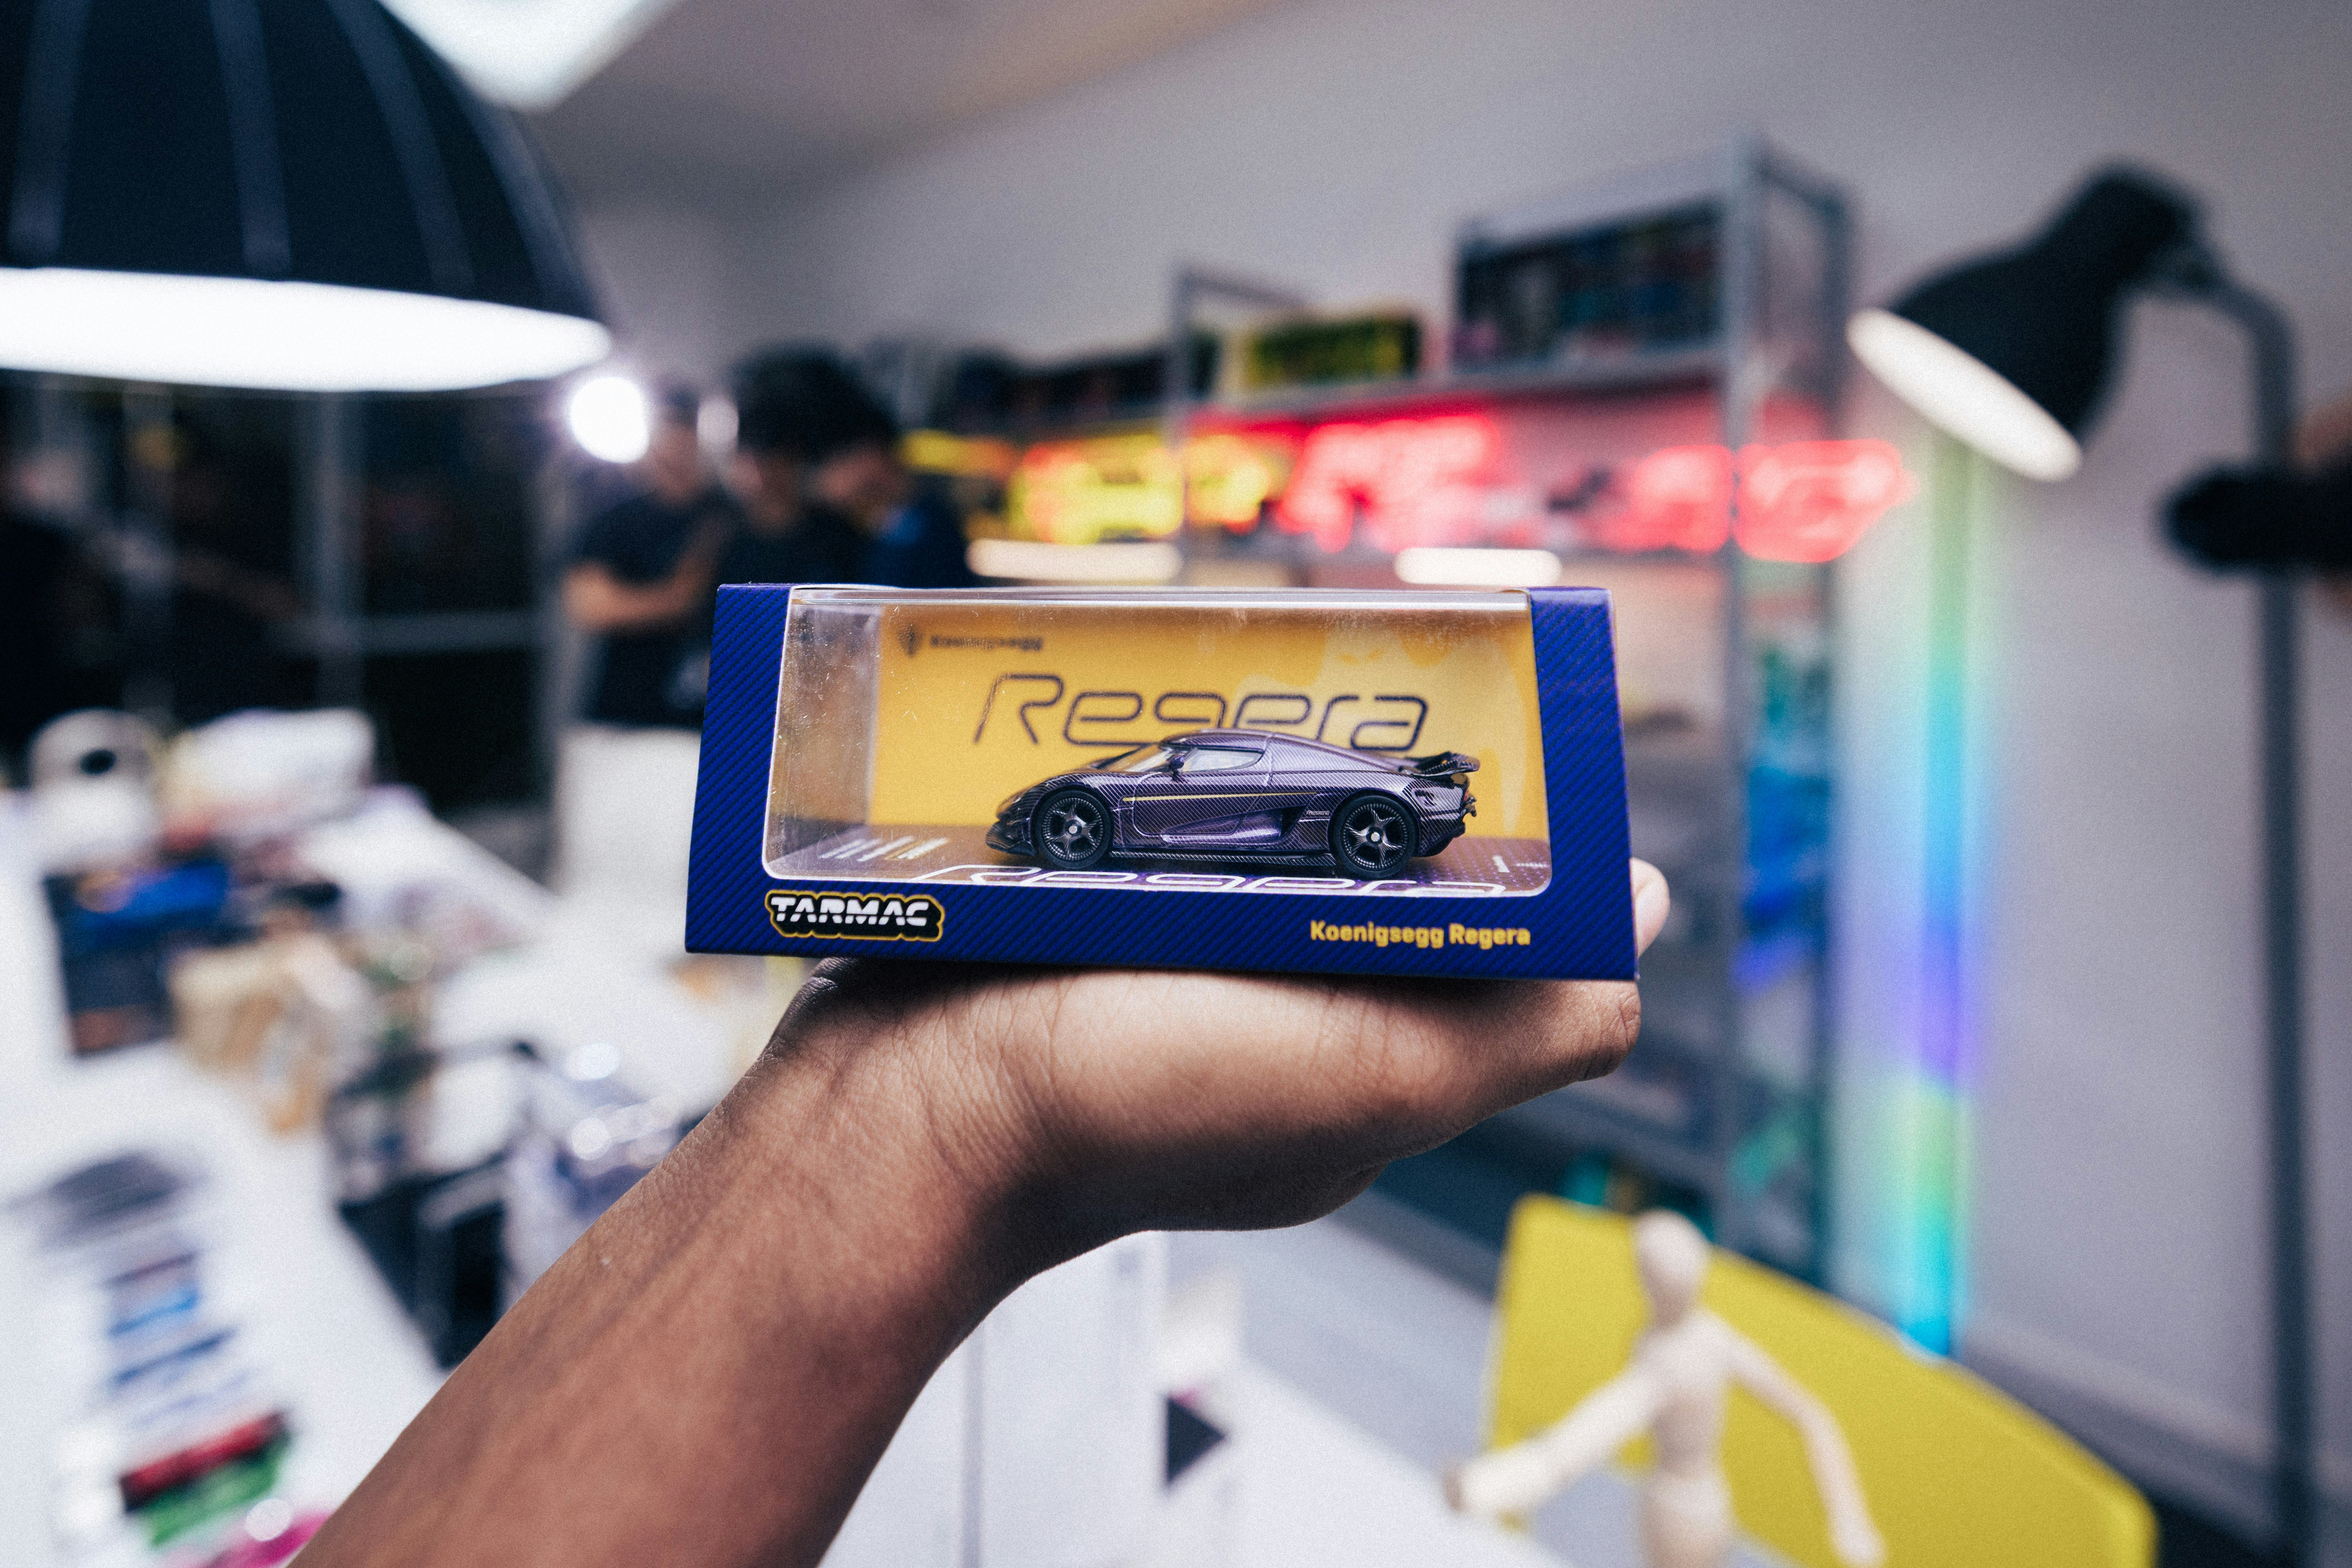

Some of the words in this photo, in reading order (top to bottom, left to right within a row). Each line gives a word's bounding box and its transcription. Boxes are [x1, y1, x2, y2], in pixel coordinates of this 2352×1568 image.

[973, 673, 1428, 751] Regera
[770, 897, 929, 926] TARMAC
[1310, 920, 1445, 949] Koenigsegg
[1448, 922, 1531, 950] Regera
